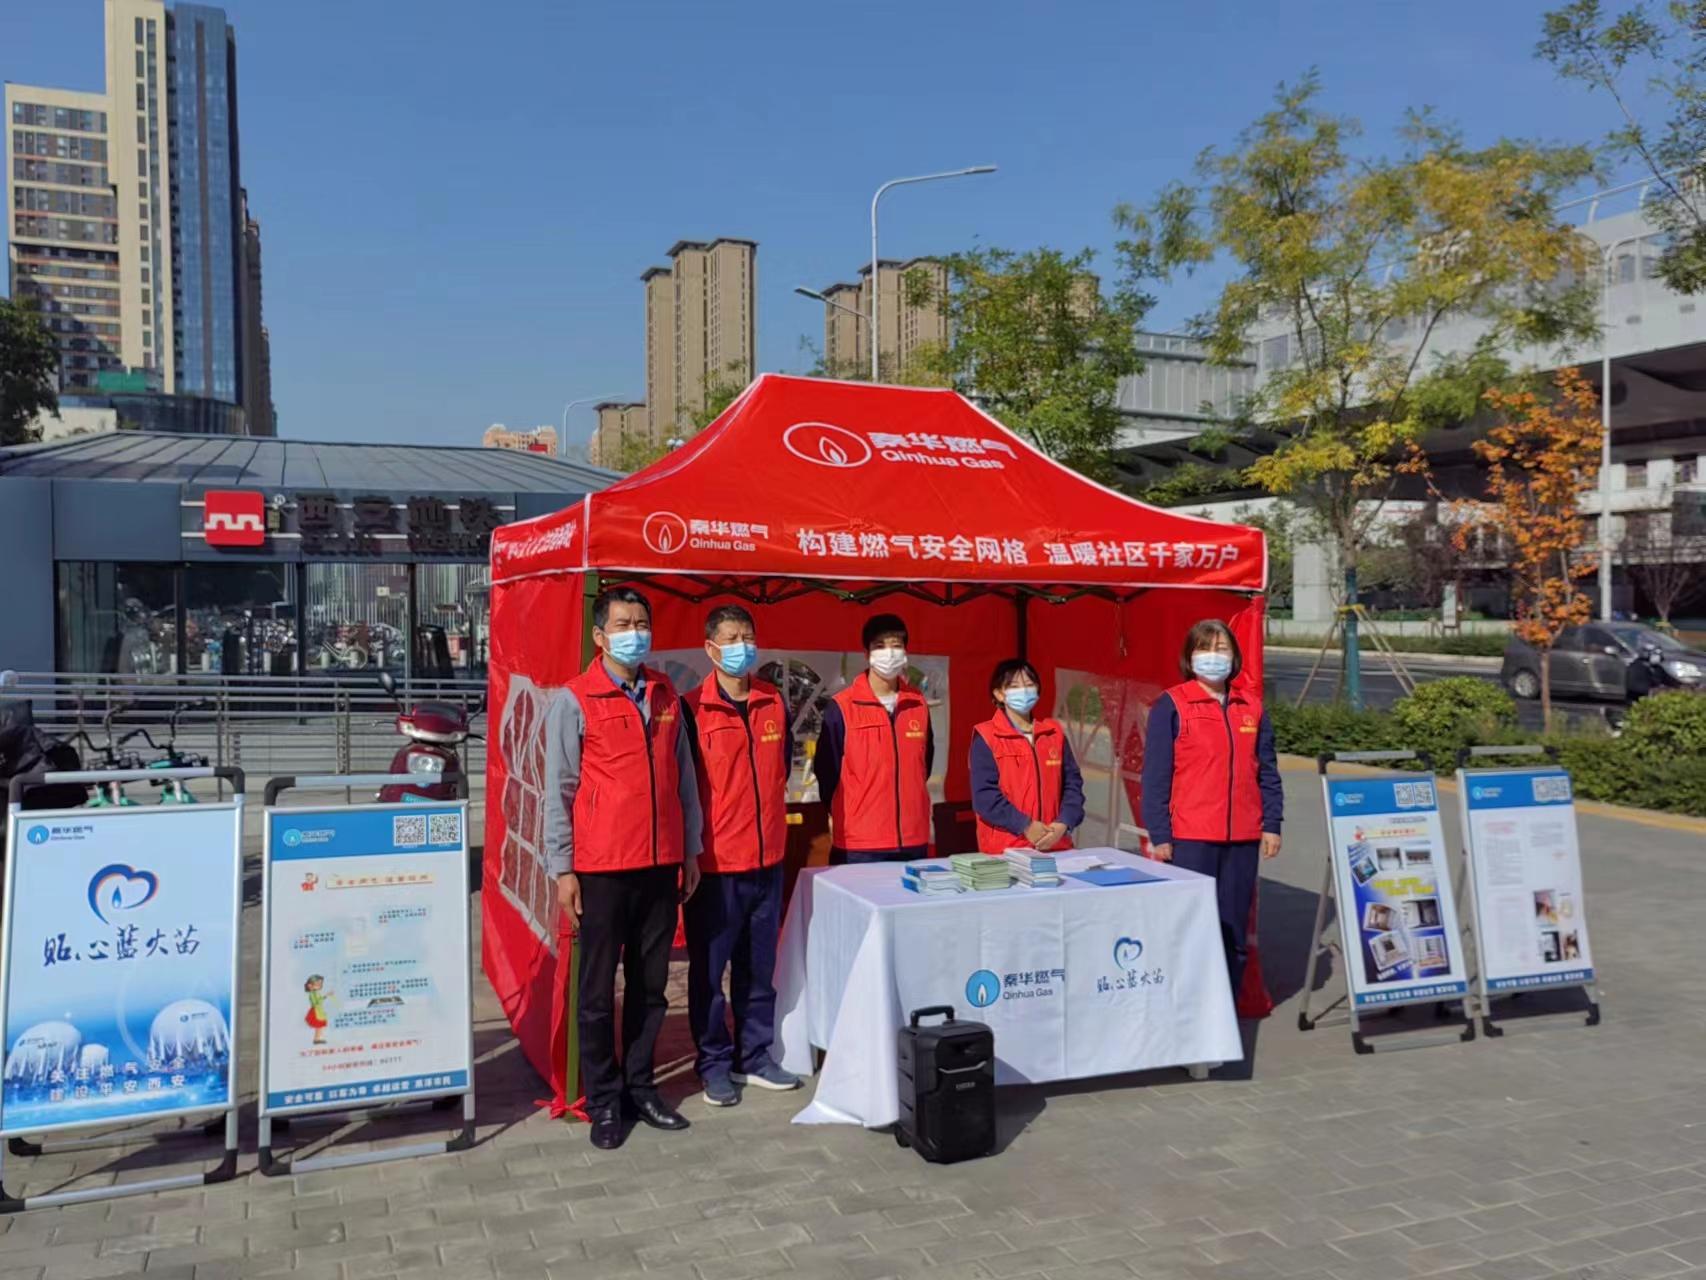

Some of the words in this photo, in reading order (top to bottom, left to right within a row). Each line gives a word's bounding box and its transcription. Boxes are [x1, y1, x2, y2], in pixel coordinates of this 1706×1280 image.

[867, 432, 1018, 459] 秦华燃气
[881, 450, 960, 467] Qinhua
[961, 457, 1005, 469] Gas
[690, 519, 769, 539] 秦华燃气
[689, 537, 732, 550] Qinhua
[733, 540, 756, 551] Gas
[796, 528, 1028, 565] 构建燃气安全网格
[1043, 541, 1240, 569] 温暖社区千家万户
[1004, 968, 1065, 988] 秦华燃气
[1002, 988, 1035, 1000] Qinhua
[1036, 987, 1053, 998] Gas
